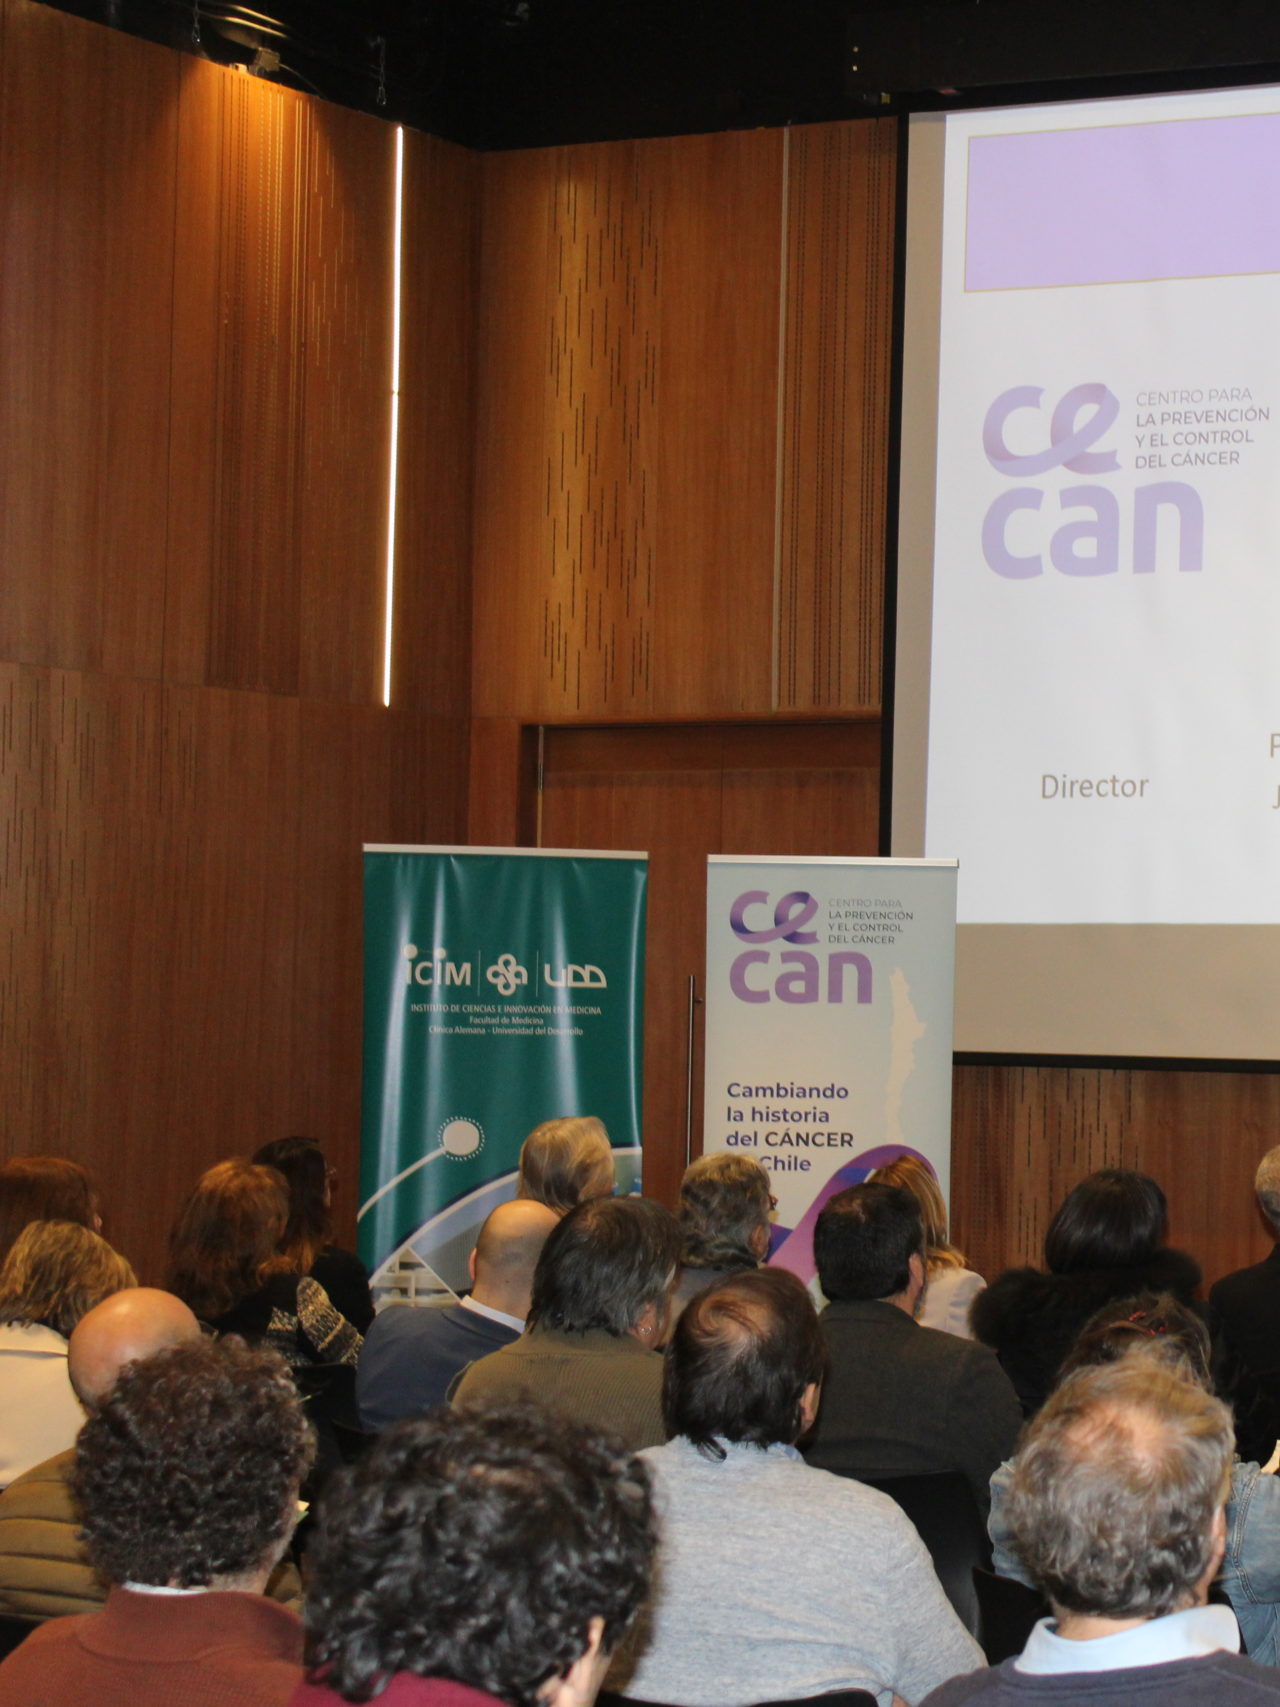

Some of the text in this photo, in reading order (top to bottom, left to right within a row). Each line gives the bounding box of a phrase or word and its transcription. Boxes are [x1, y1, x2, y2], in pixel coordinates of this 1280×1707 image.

[1136, 387, 1253, 407] CENTRO PARA
[1135, 405, 1271, 428] LA PREVENCIÓN
[1135, 429, 1254, 449] Y EL CONTROL
[1135, 450, 1241, 470] DEL CÁNCER
[981, 480, 1204, 580] can
[1040, 773, 1149, 800] Director
[828, 898, 902, 909] CENTRO PARA
[828, 910, 914, 920] LA PREVENCIÓN
[828, 923, 904, 933] Y EL CONTROL
[828, 933, 895, 944] DEL CÁNCER
[729, 949, 873, 1005] can
[411, 1003, 449, 1012] INSTITUTO
[450, 1004, 460, 1012] DE
[462, 1004, 496, 1013] CIENCIAS
[565, 1006, 602, 1015] MEDICINA
[470, 1016, 544, 1025] Facultad de Medicina
[454, 1025, 486, 1035] Alemana
[492, 1026, 534, 1036] Universidad
[535, 1026, 546, 1036] del
[726, 1082, 849, 1100] Cambiando
[726, 1106, 830, 1123] la historia
[725, 1127, 854, 1148] del CÁNCER
